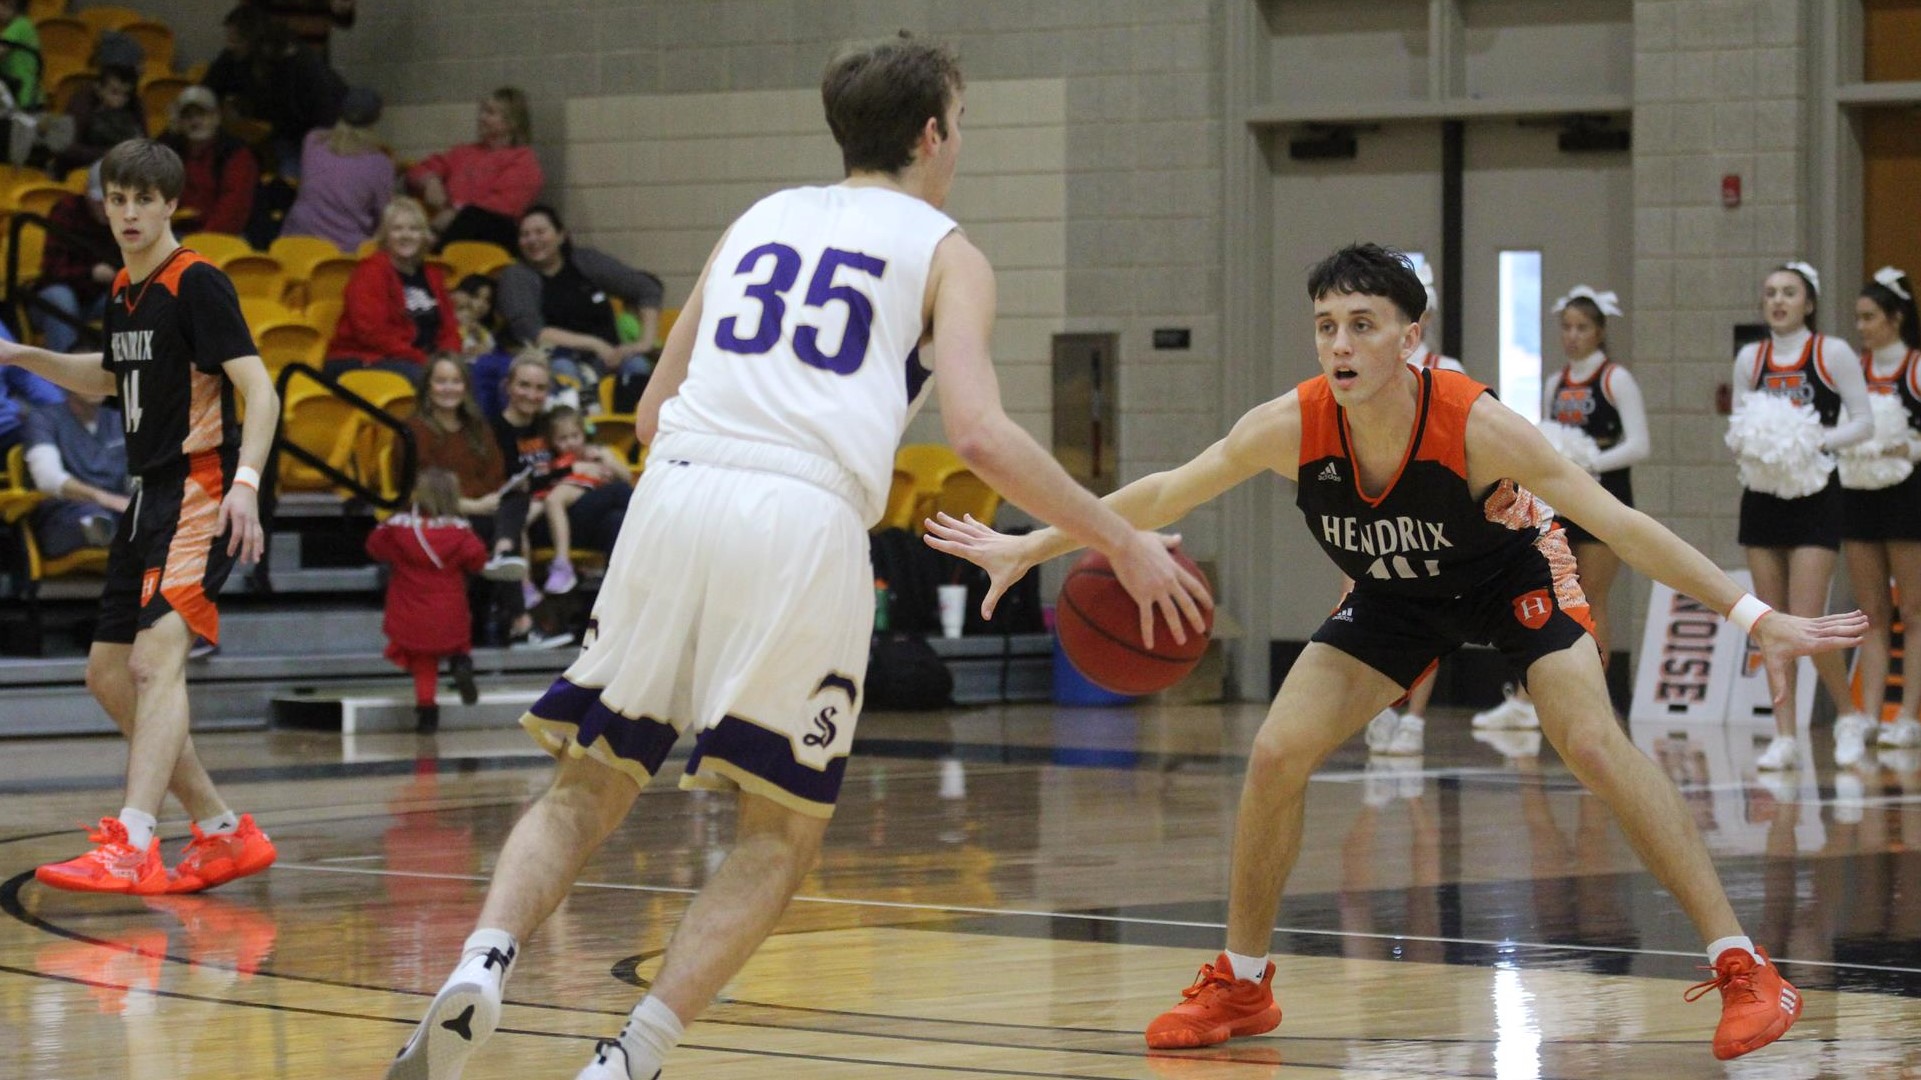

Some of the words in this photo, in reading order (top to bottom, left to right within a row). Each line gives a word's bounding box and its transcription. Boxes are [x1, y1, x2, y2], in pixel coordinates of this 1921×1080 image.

[713, 241, 887, 376] 35
[1321, 514, 1455, 557] HENDRIX
[1522, 596, 1548, 621] H
